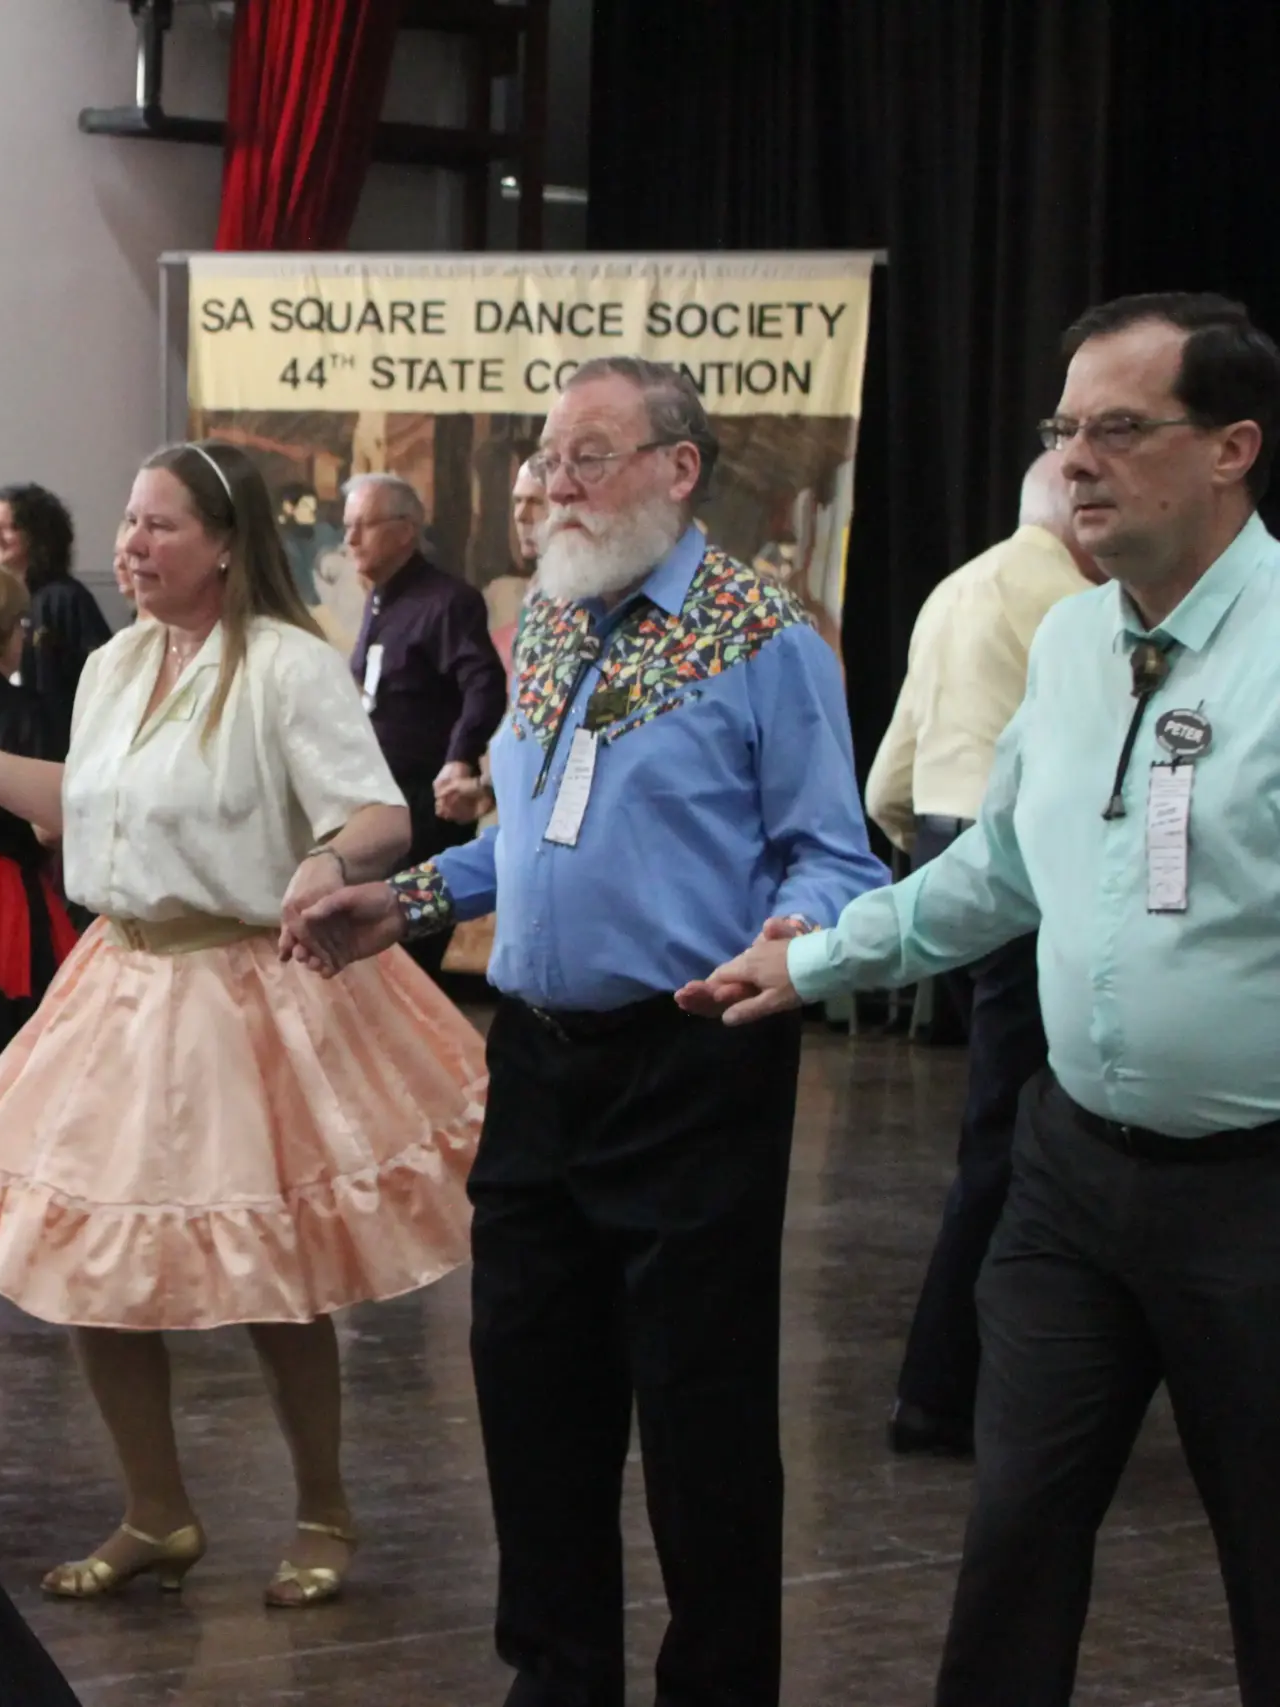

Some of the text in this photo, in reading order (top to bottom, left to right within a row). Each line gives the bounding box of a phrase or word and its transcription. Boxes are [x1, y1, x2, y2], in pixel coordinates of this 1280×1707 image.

[201, 297, 847, 339] SA SQUARE DANCE SOCIETY
[279, 352, 812, 396] 44TH STATE CNTION
[1163, 719, 1205, 744] PETER
